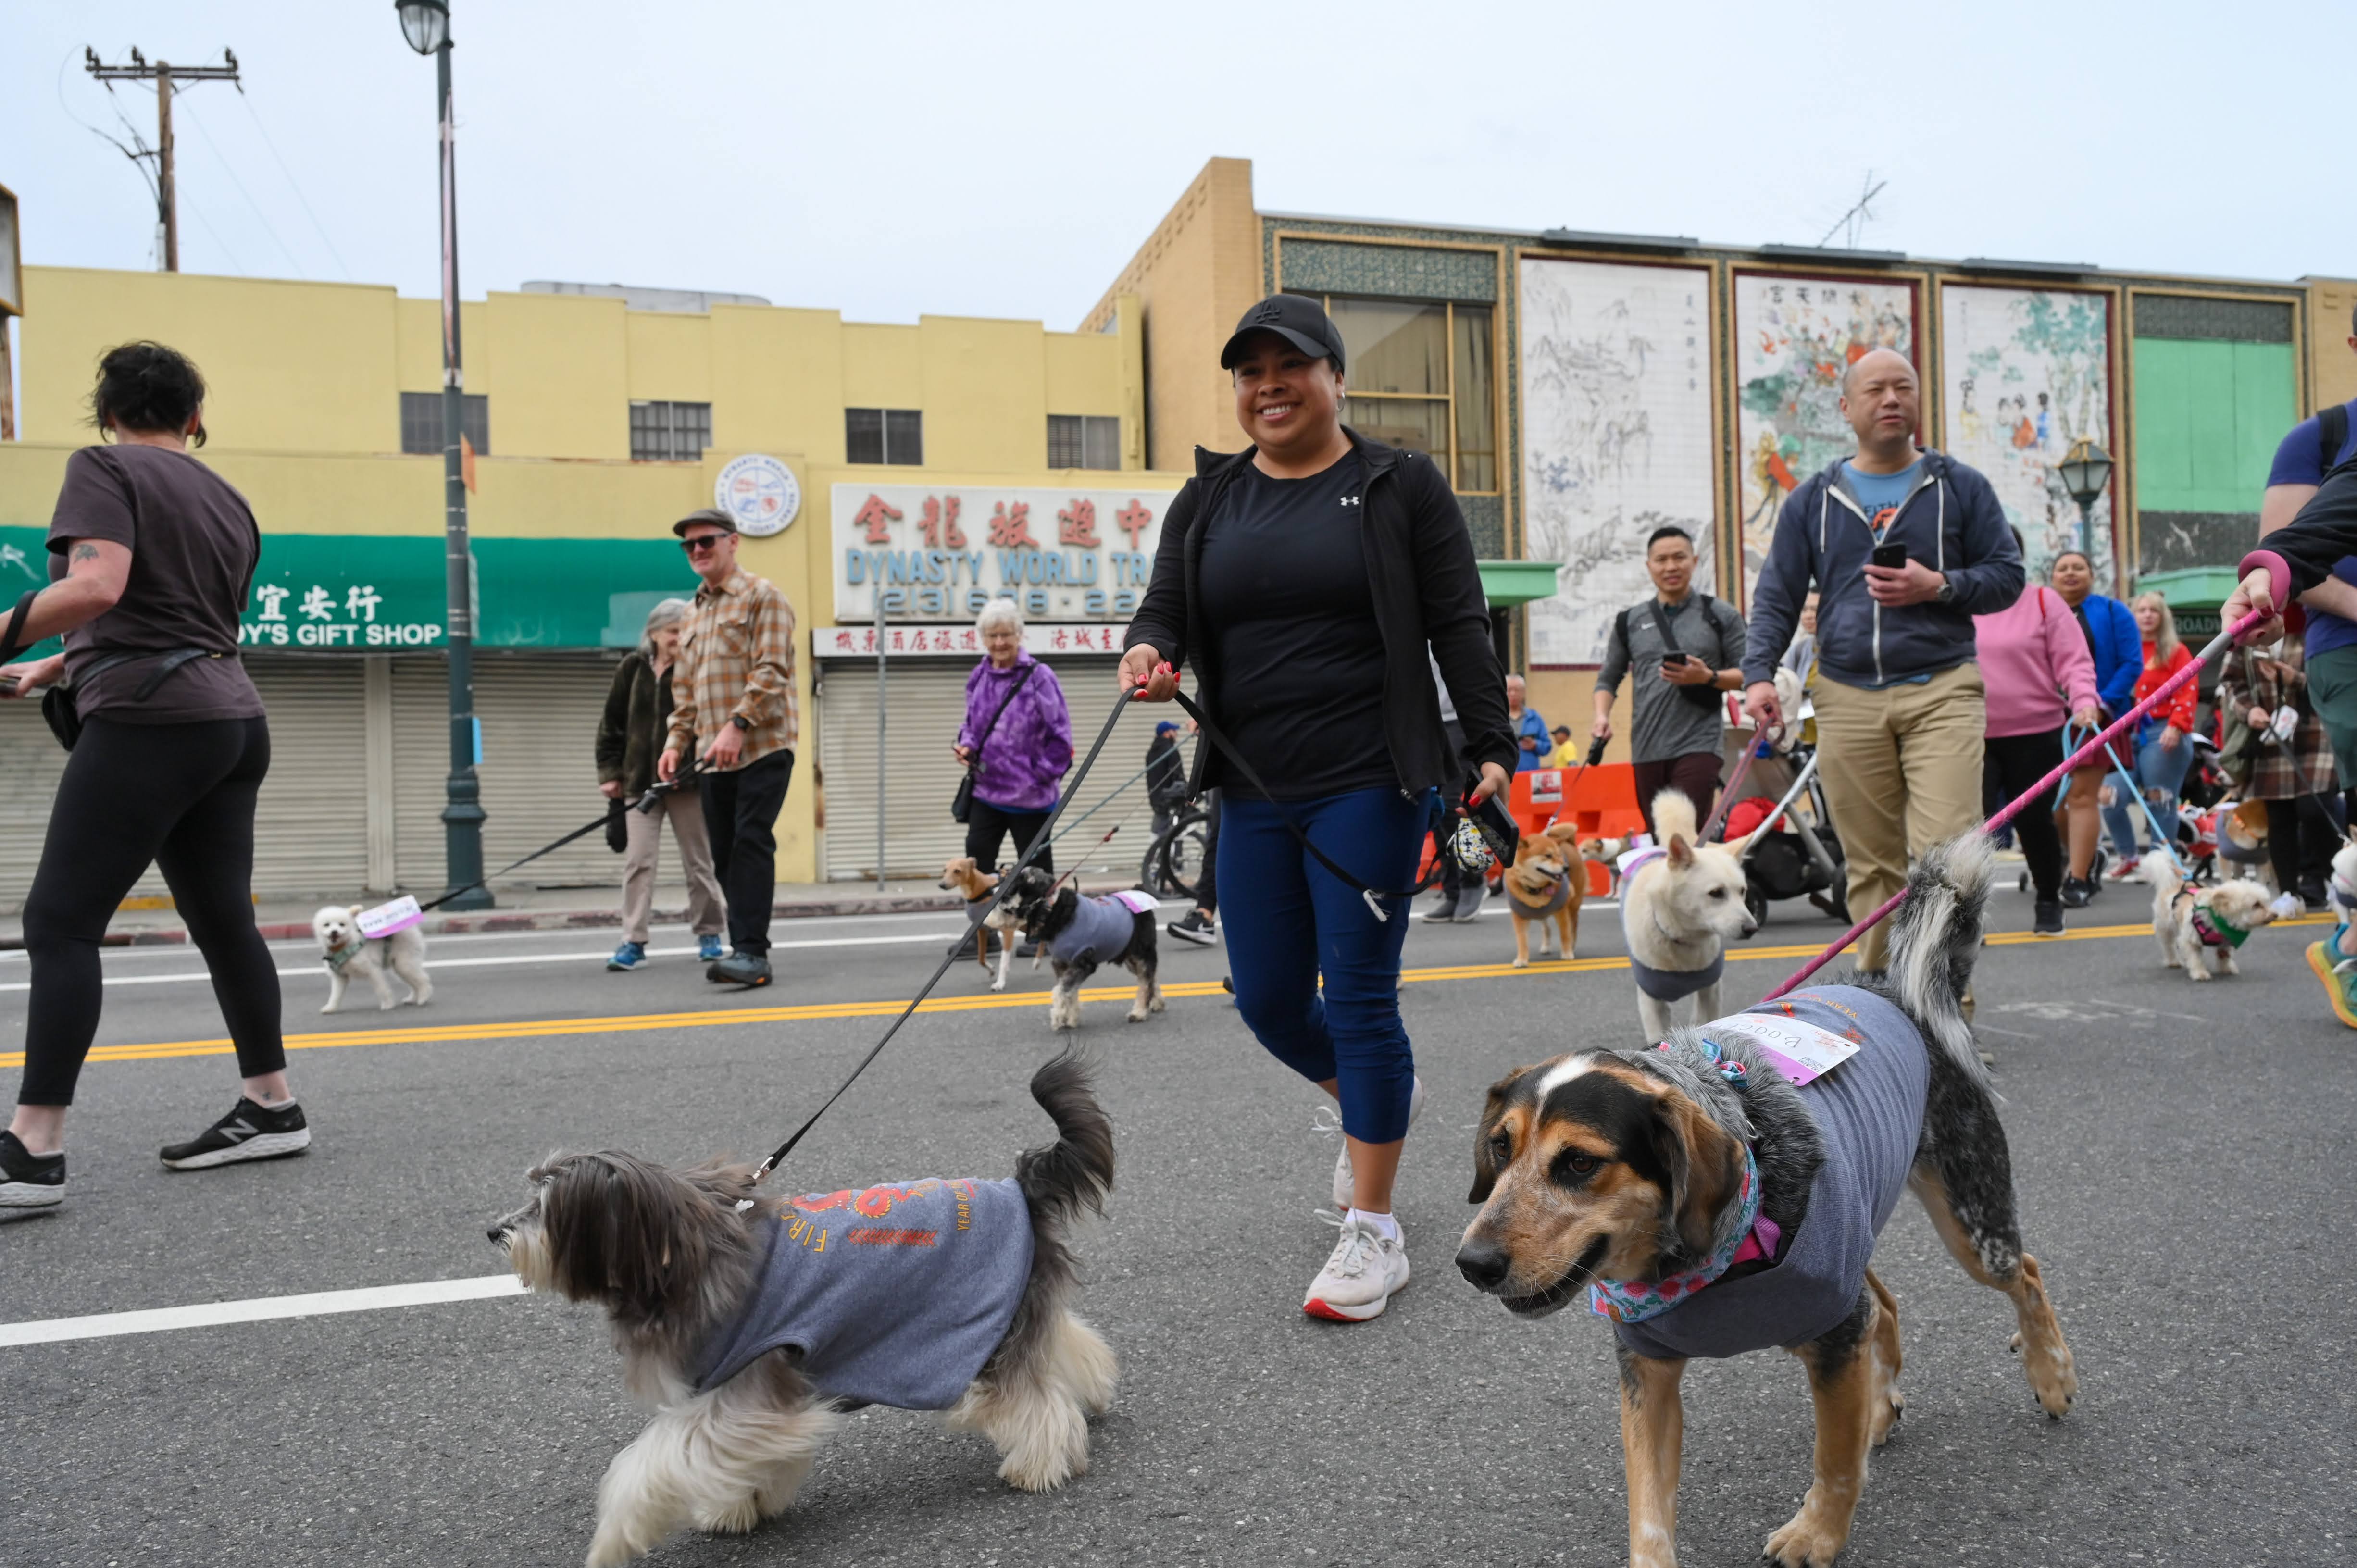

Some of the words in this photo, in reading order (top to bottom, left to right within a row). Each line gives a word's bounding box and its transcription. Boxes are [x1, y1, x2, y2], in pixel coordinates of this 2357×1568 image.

[846, 549, 984, 585] DYNASTY
[996, 551, 1098, 586] WORLD
[1110, 552, 1156, 586] TR
[256, 583, 383, 622] 宜安行
[296, 624, 360, 646] GIFT
[365, 624, 442, 646] SHOP
[954, 1190, 969, 1202] OF
[957, 1203, 970, 1231] YEAR
